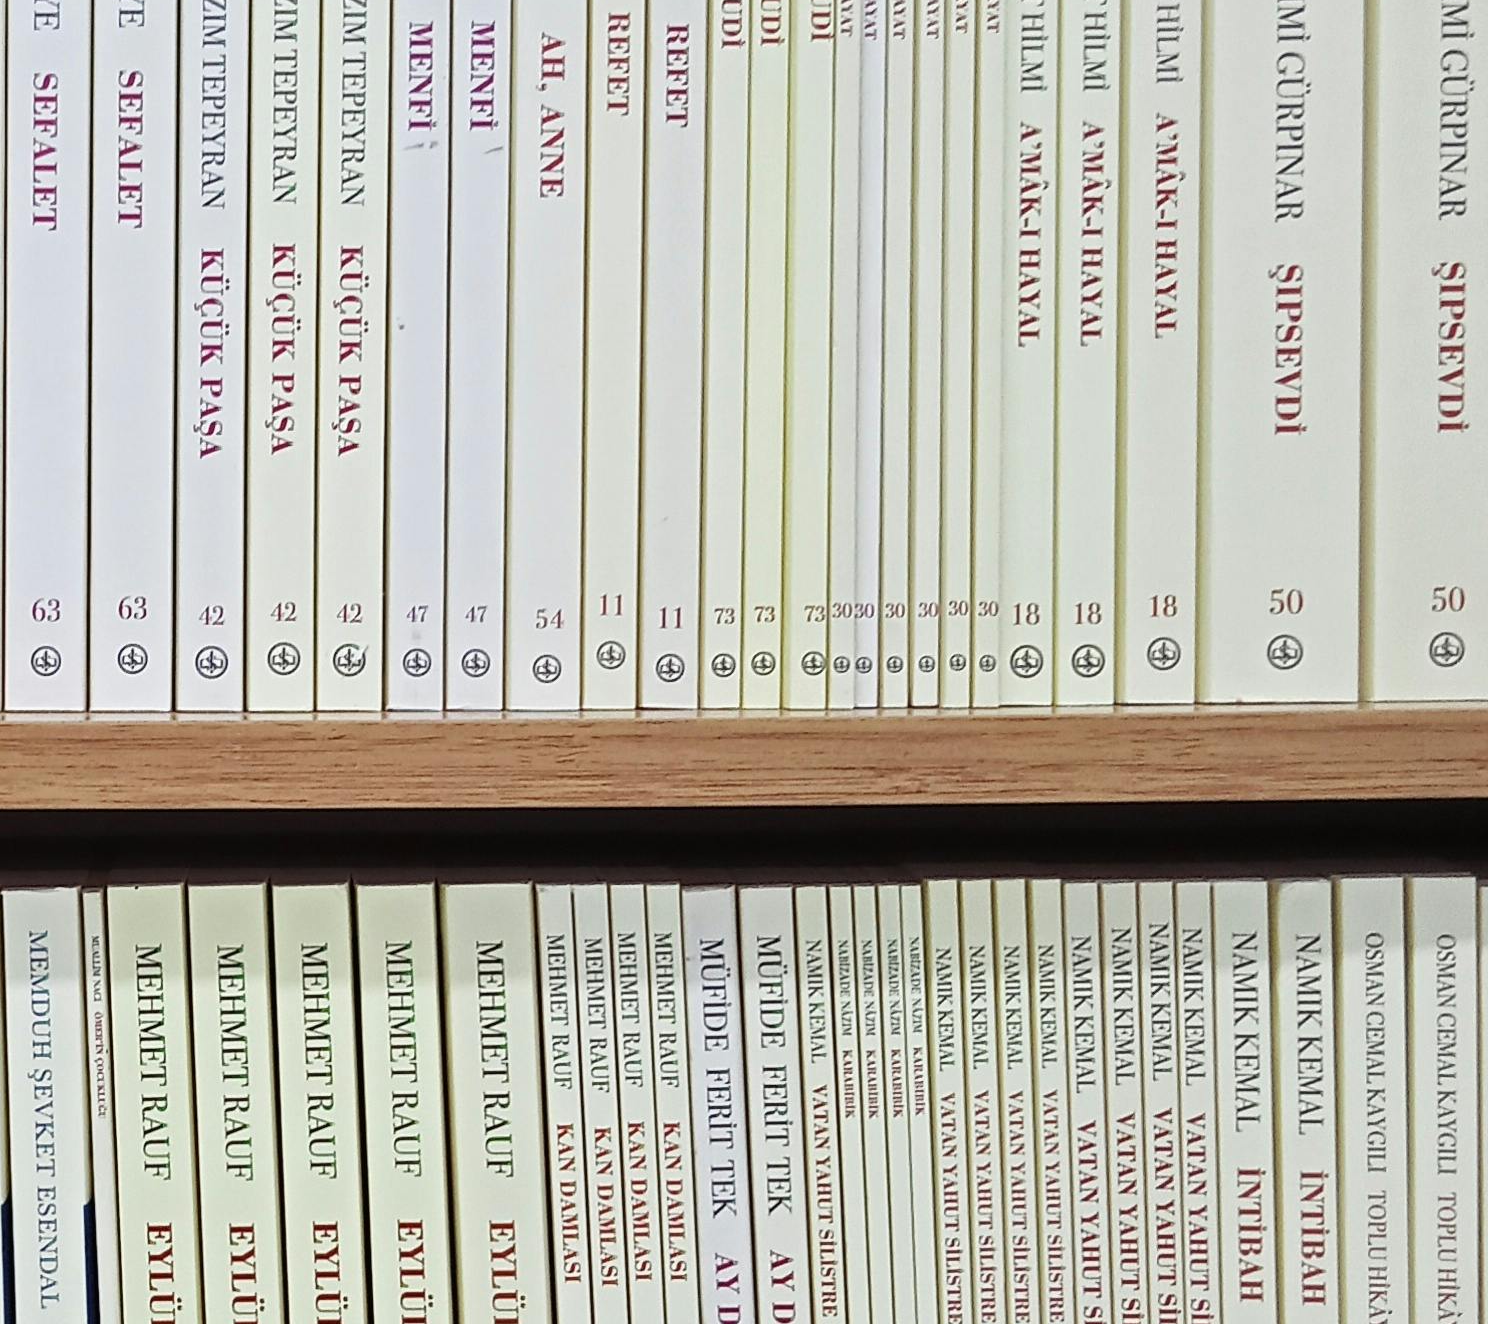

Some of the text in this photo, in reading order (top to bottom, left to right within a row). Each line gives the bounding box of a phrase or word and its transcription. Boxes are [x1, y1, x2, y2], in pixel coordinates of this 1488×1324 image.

[271, 47, 299, 205] TEPEYRAN
[1274, 51, 1312, 224] GÜRPINAR
[264, 242, 303, 364] KÜÇÜK
[1267, 263, 1309, 436] ŞIPSEVDİ
[264, 371, 296, 456] PAŞA
[269, 601, 298, 623] 42
[977, 600, 1002, 621] 30
[1268, 587, 1304, 616] 50
[1148, 921, 1172, 1001] NAMIK
[300, 941, 334, 1087] MEHMET
[1150, 1001, 1174, 1083] KEMAL
[306, 1091, 338, 1180] RAUF
[1152, 1106, 1176, 1192] VATAN
[1154, 1198, 1178, 1288] YAHUT
